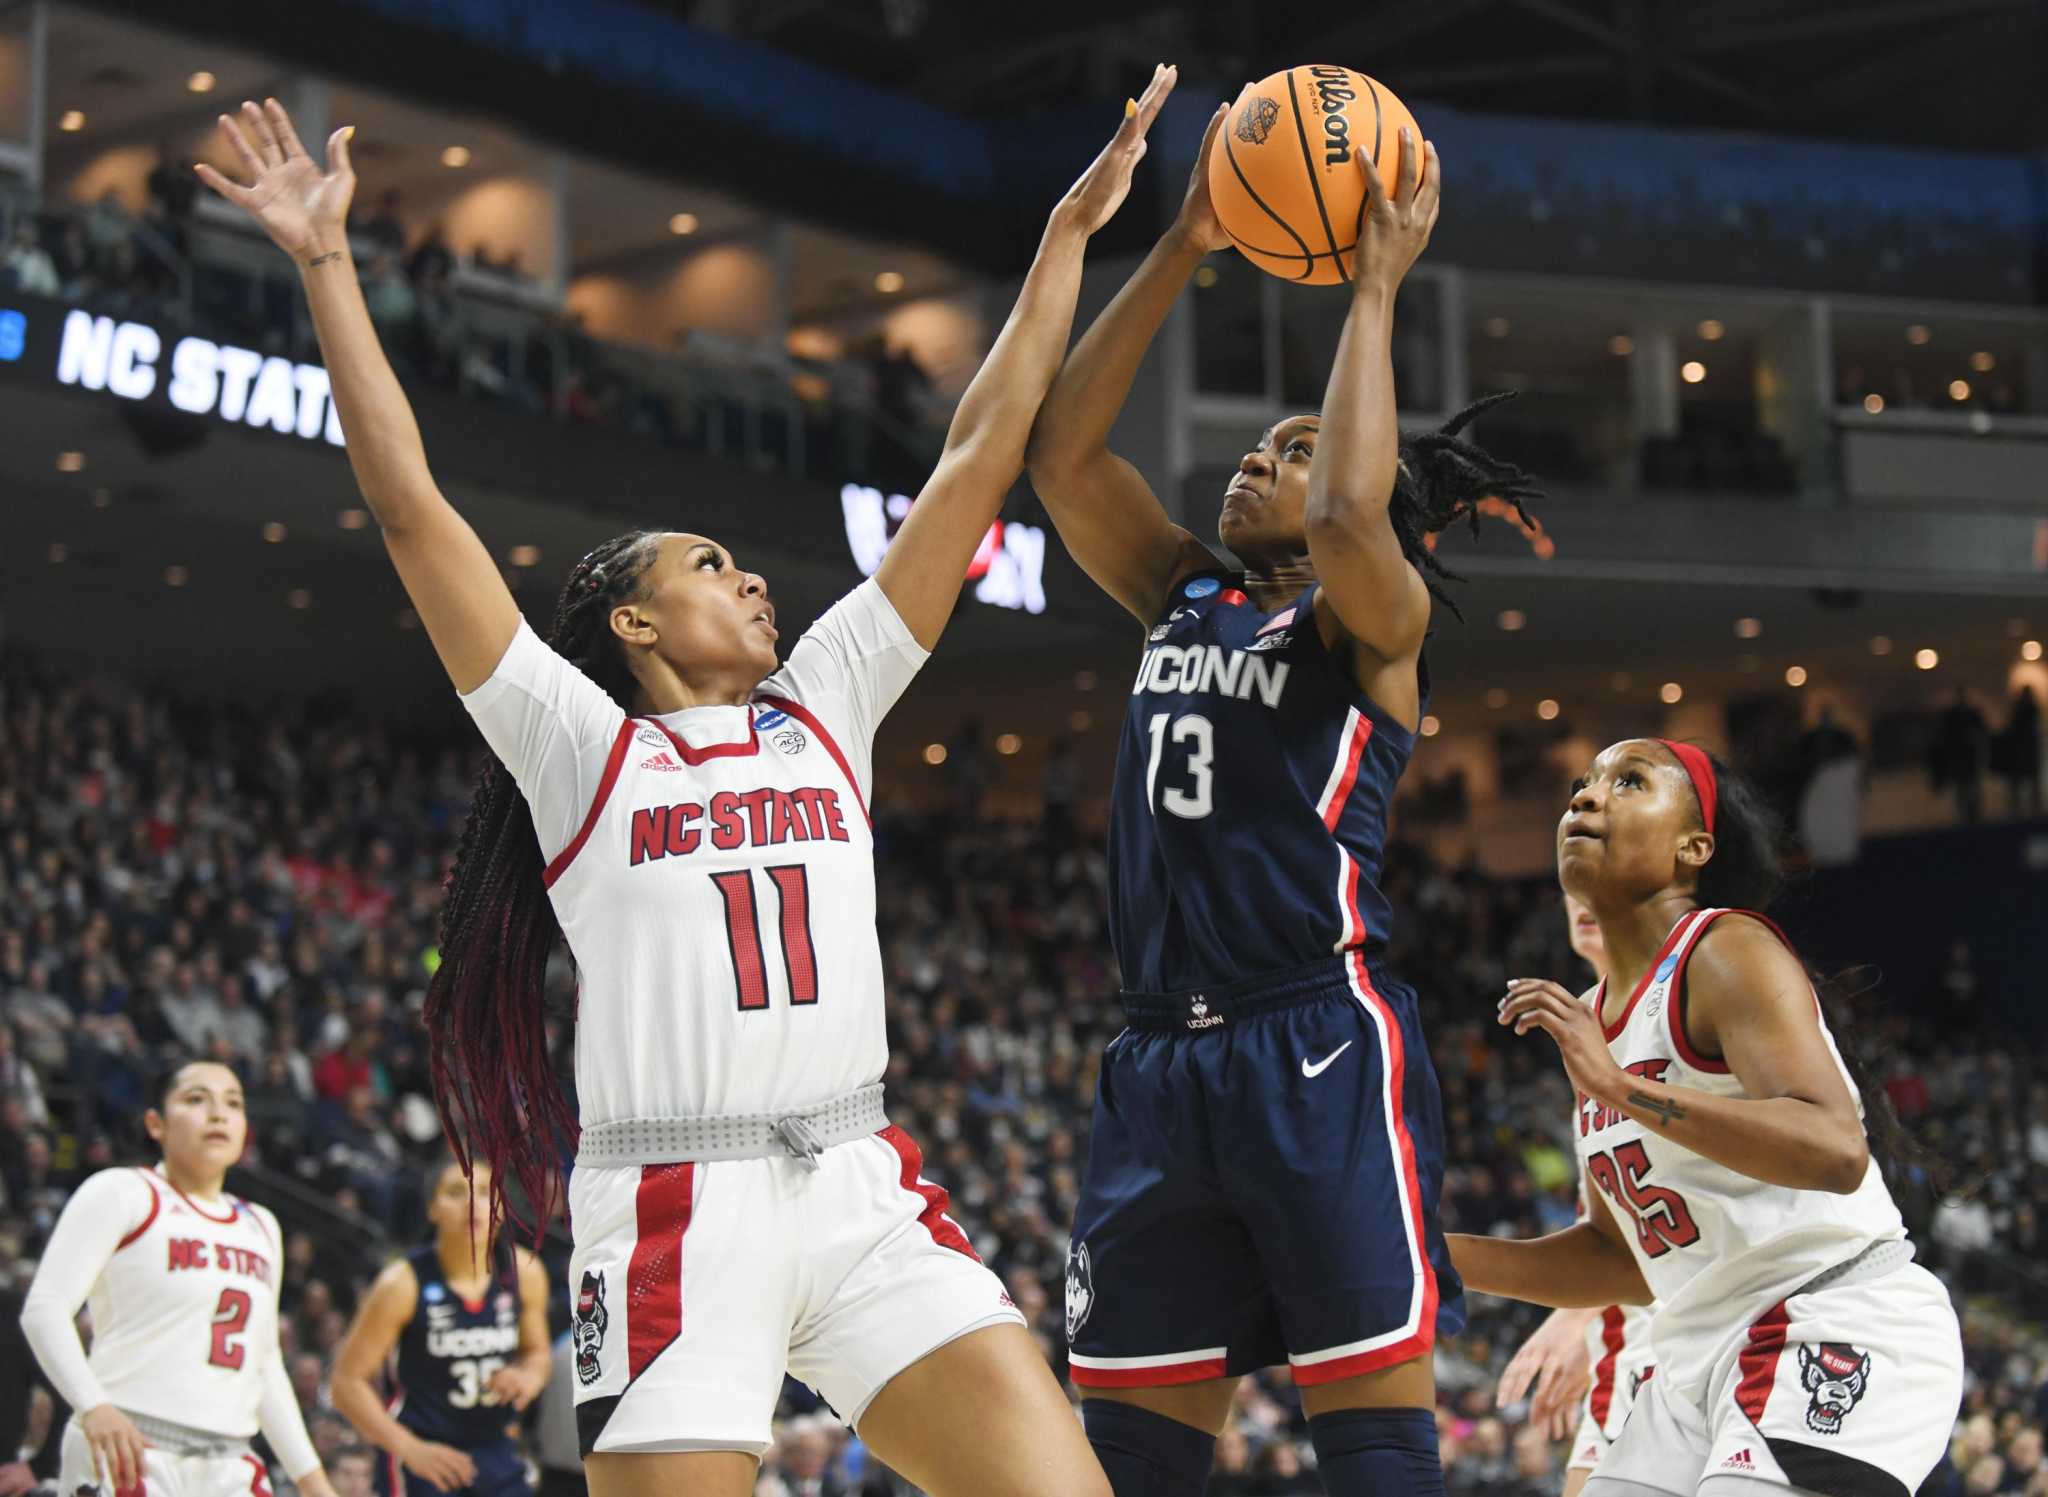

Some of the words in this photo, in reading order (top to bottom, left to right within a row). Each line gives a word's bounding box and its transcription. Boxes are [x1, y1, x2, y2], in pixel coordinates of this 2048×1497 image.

[58, 309, 161, 399] NC
[1133, 645, 1291, 709] UCONN
[640, 761, 682, 772] adidas
[779, 734, 802, 746] ACC
[1146, 713, 1214, 819] 13
[630, 802, 704, 866] NC
[710, 787, 850, 850] STATE
[708, 863, 818, 1011] 11
[1187, 1014, 1225, 1029] UCONN
[168, 1238, 208, 1272] NC
[208, 1288, 252, 1372] 2
